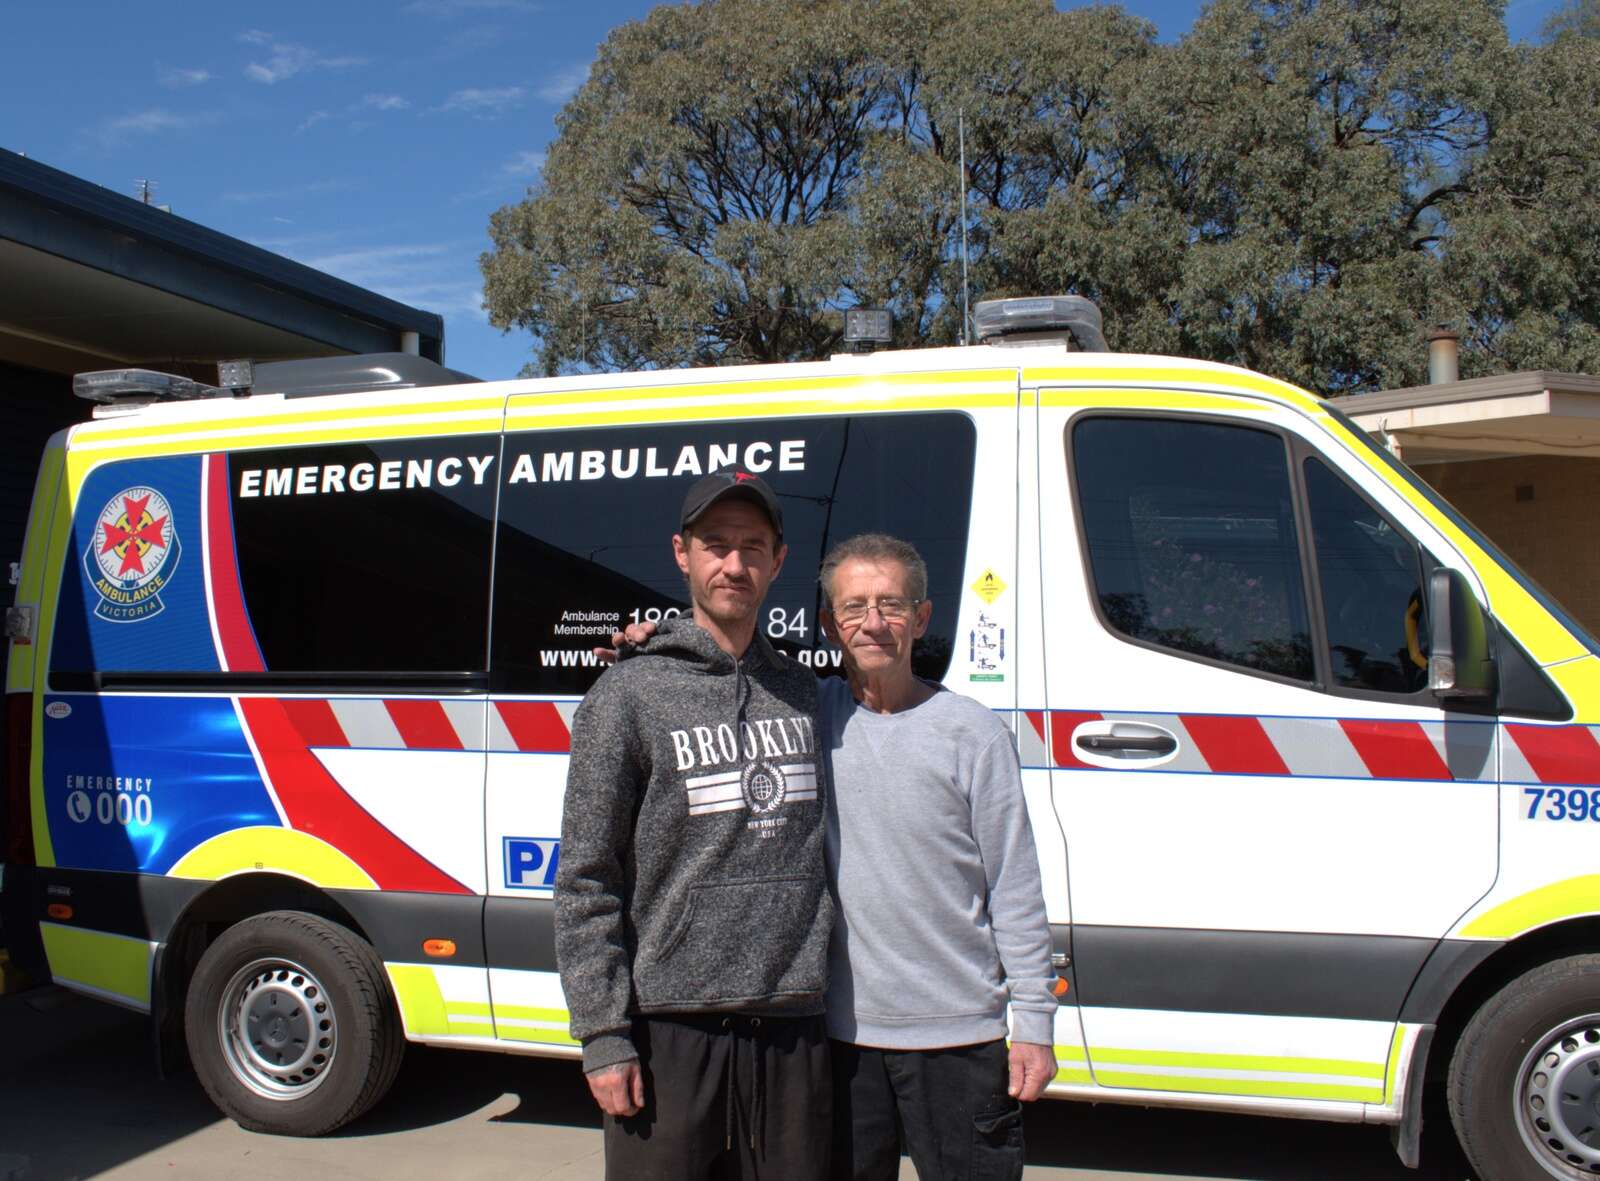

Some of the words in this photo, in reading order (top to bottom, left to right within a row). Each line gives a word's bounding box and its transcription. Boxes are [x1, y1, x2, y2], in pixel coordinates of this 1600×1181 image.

[240, 456, 494, 497] EMERGENCY
[509, 440, 806, 484] AMBULANCE
[96, 575, 164, 603] AMBULANCE
[103, 601, 157, 617] VICTORIA
[561, 610, 620, 622] Ambulance
[554, 624, 620, 635] Membership
[767, 607, 809, 638] 84
[670, 716, 817, 771] BROOKLYN
[66, 775, 152, 792] EMERGENCY
[96, 791, 153, 827] 000
[747, 820, 759, 829] NEW
[760, 818, 776, 828] YORK
[762, 830, 776, 839] USA
